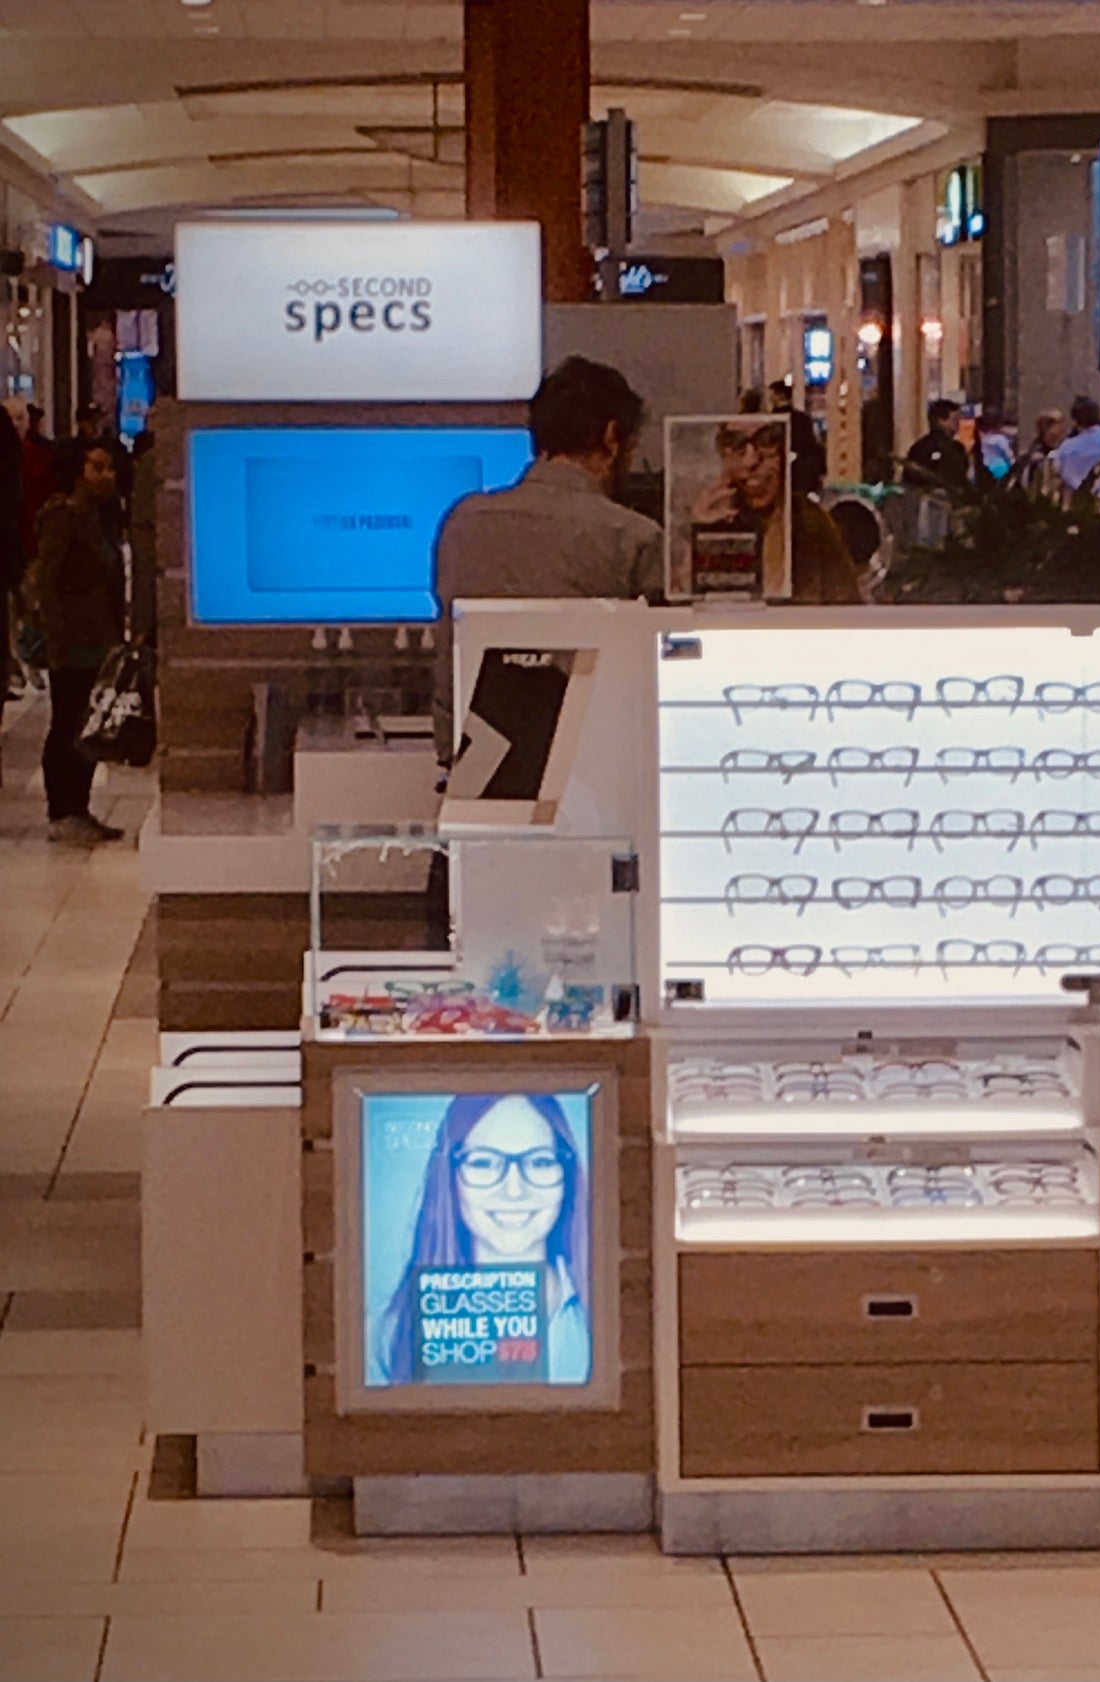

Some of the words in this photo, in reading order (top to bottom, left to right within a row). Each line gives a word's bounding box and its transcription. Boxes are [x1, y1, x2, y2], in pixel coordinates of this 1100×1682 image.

[337, 276, 433, 298] SECOND
[284, 299, 432, 343] specs
[420, 1270, 537, 1291] PRESCRIPTION
[420, 1290, 537, 1315] GLASSES
[422, 1316, 490, 1340] WHILE
[493, 1315, 538, 1338] YOU
[421, 1340, 498, 1367] SHOP
